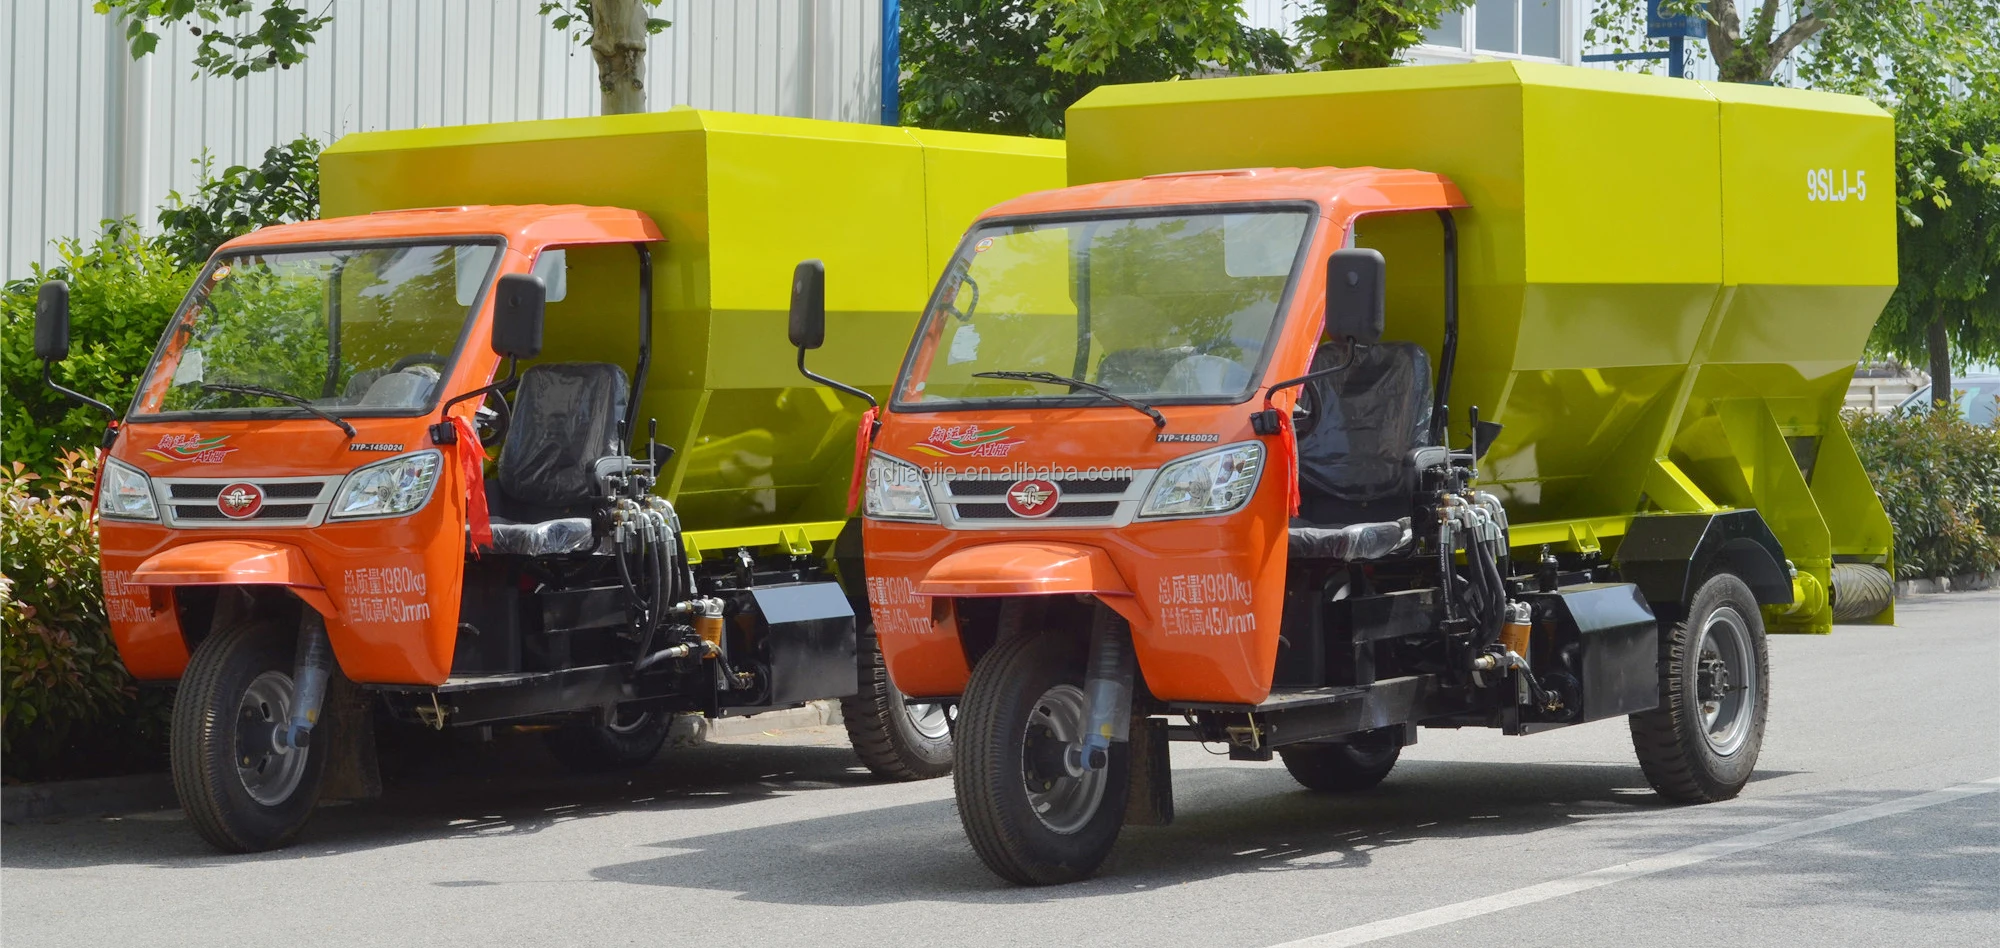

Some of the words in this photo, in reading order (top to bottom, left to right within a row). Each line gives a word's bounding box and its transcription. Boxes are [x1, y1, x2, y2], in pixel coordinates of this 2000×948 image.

[1807, 168, 1866, 201] 9SLJ-5
[350, 443, 403, 451] 7YP-1450D24
[1157, 434, 1218, 442] 7YP-1450D24
[344, 566, 426, 597] 总质量1980kg
[1159, 573, 1252, 605] 总质量1980kg
[347, 597, 431, 624] 栏板高450mm
[1161, 607, 1256, 636] 栏板高450mm
